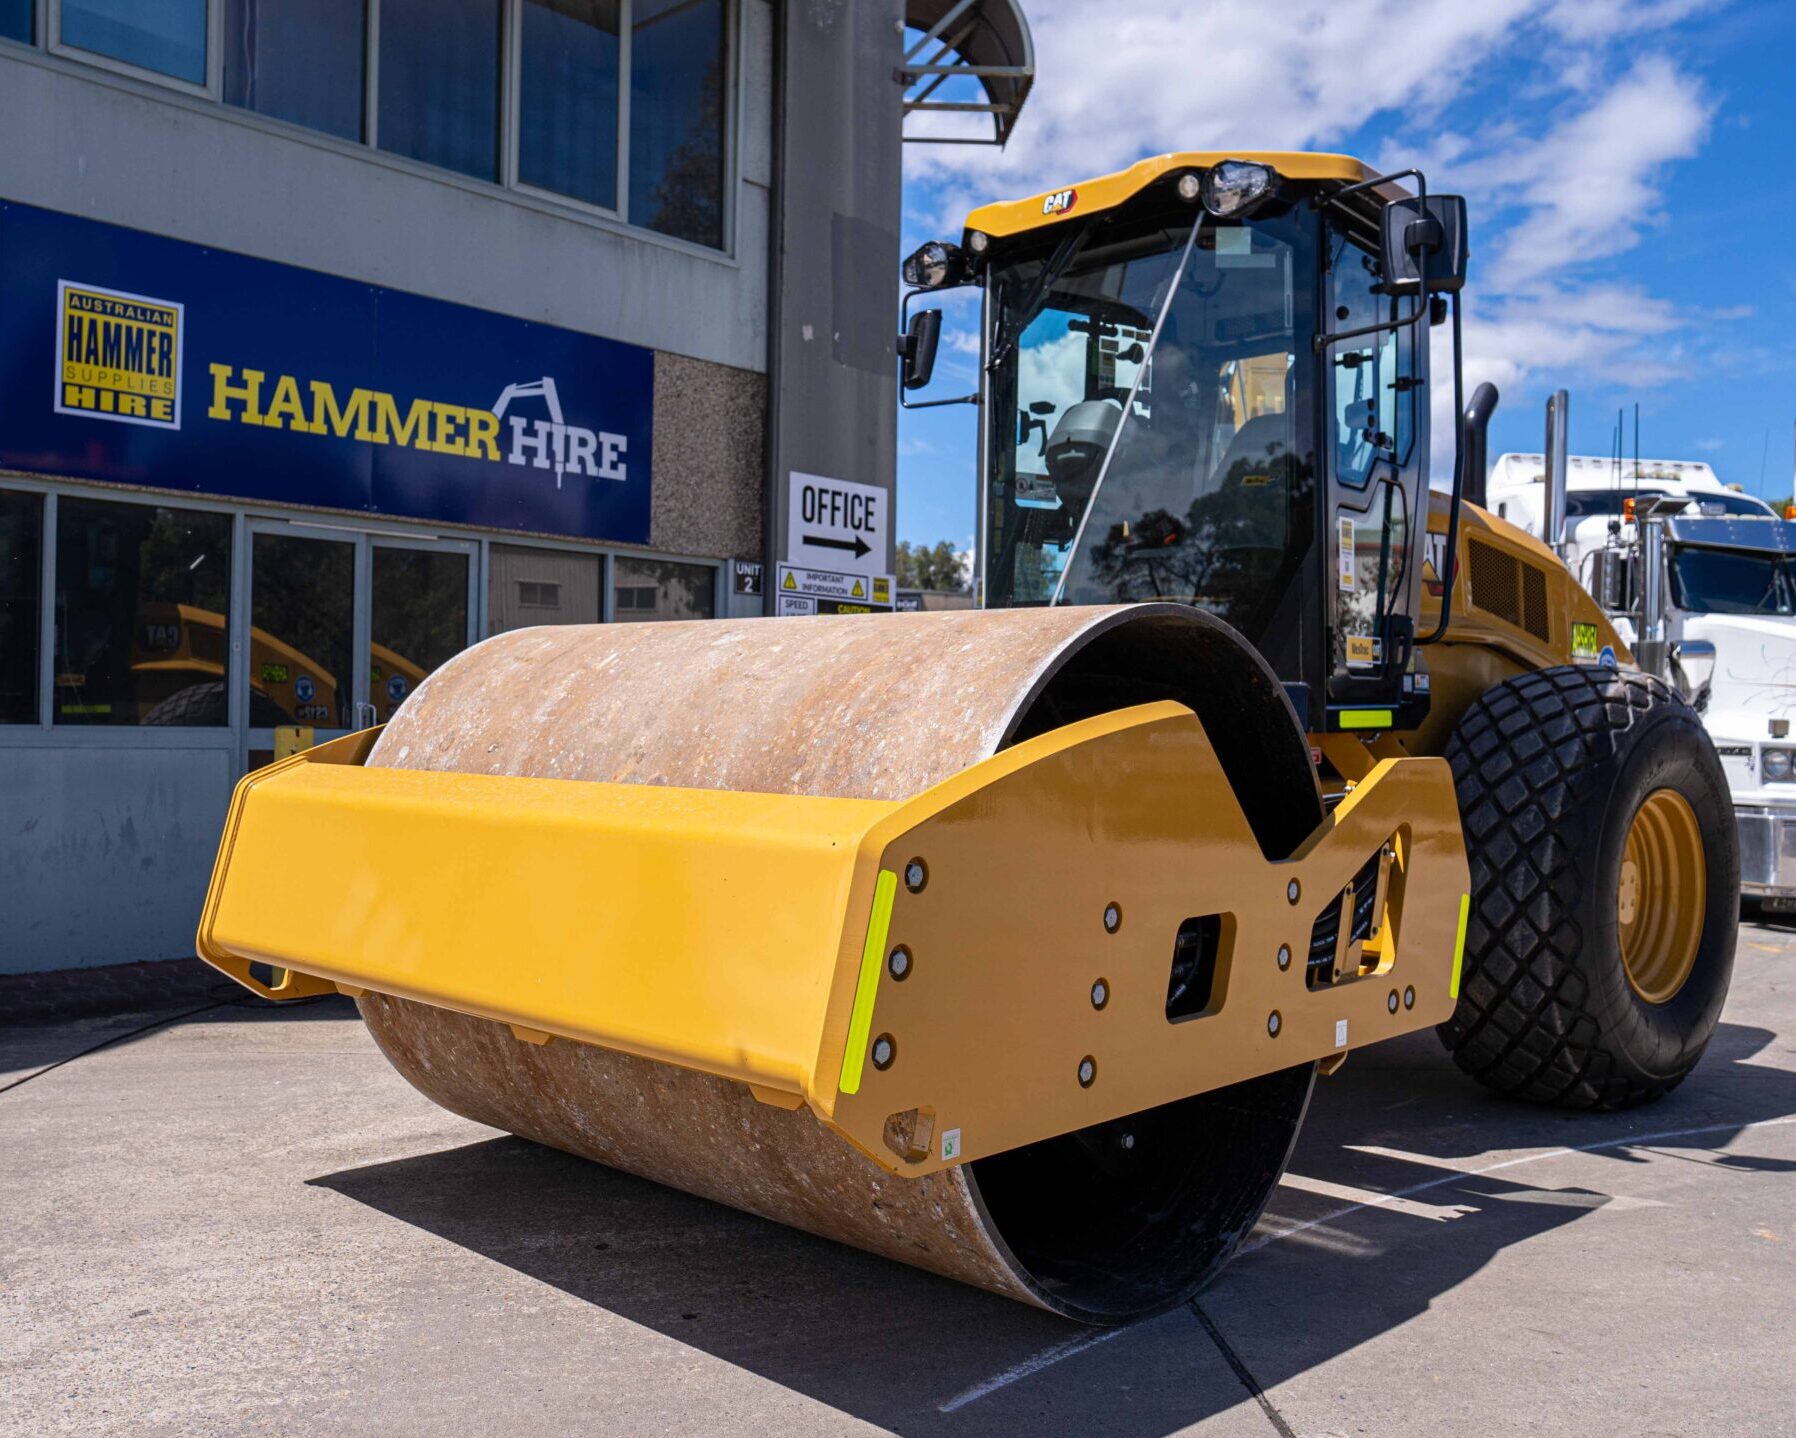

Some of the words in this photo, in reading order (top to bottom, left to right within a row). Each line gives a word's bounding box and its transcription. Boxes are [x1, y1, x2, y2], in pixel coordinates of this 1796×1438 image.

[1042, 190, 1073, 214] CAT
[70, 295, 173, 325] AUSTRALIAN
[67, 315, 173, 378] HAMMER
[66, 366, 173, 395] SUPPLIES
[64, 385, 173, 421] HIRE
[208, 363, 501, 461] HAMMER
[508, 415, 627, 482] HIRE
[802, 485, 876, 532] OFFICE
[736, 563, 761, 576] UNIT
[806, 573, 844, 584] IMPORTANT
[744, 578, 754, 593] 2
[802, 584, 848, 596] INFORMATION
[785, 600, 808, 610] SPEED
